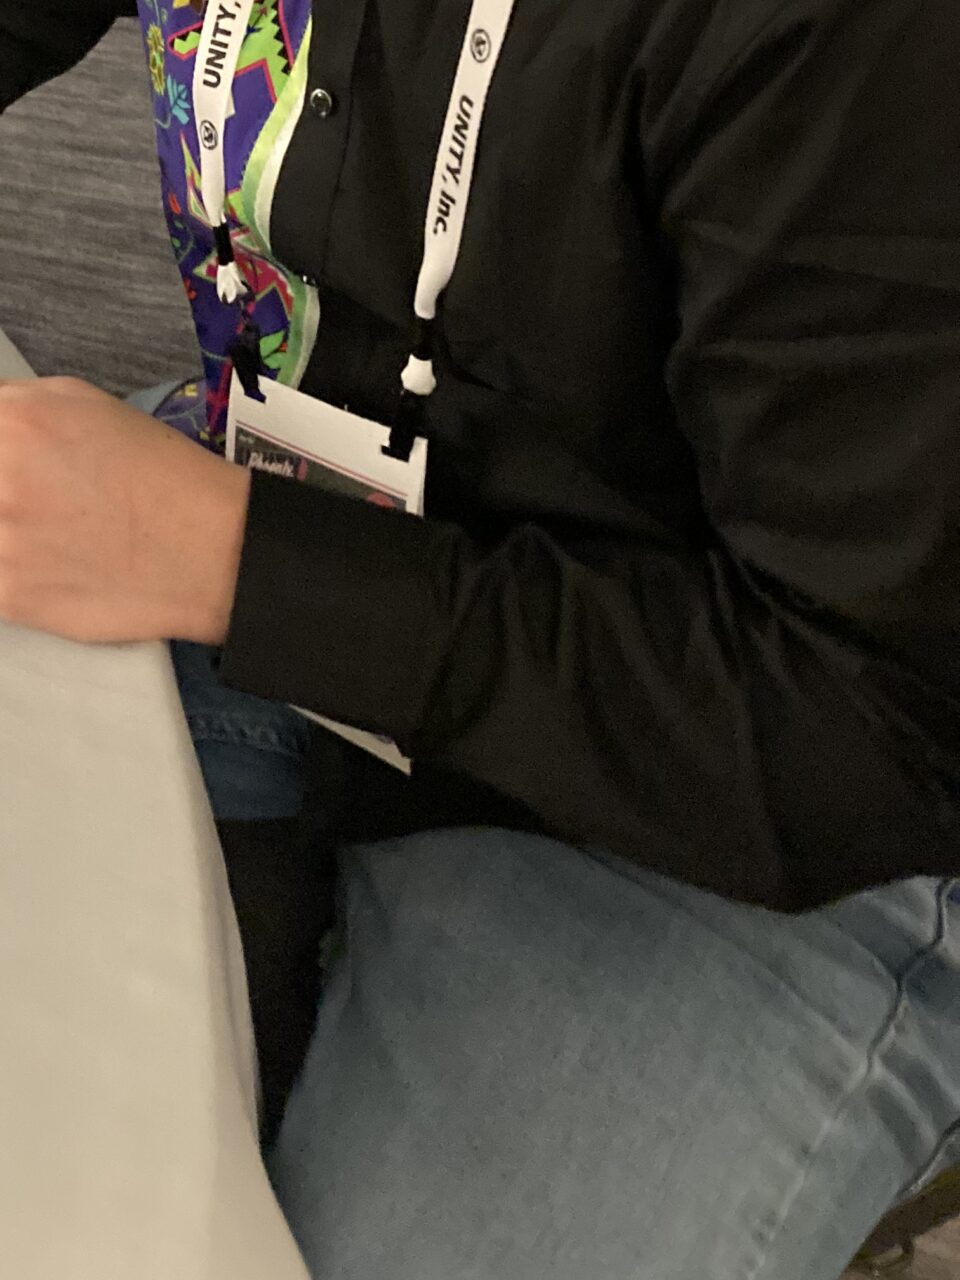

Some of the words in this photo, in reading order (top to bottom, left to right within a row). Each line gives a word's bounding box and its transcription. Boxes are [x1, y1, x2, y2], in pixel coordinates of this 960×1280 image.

[203, 0, 242, 89] UNITY,
[440, 94, 474, 186] UNITY,
[433, 187, 458, 237] Inc.
